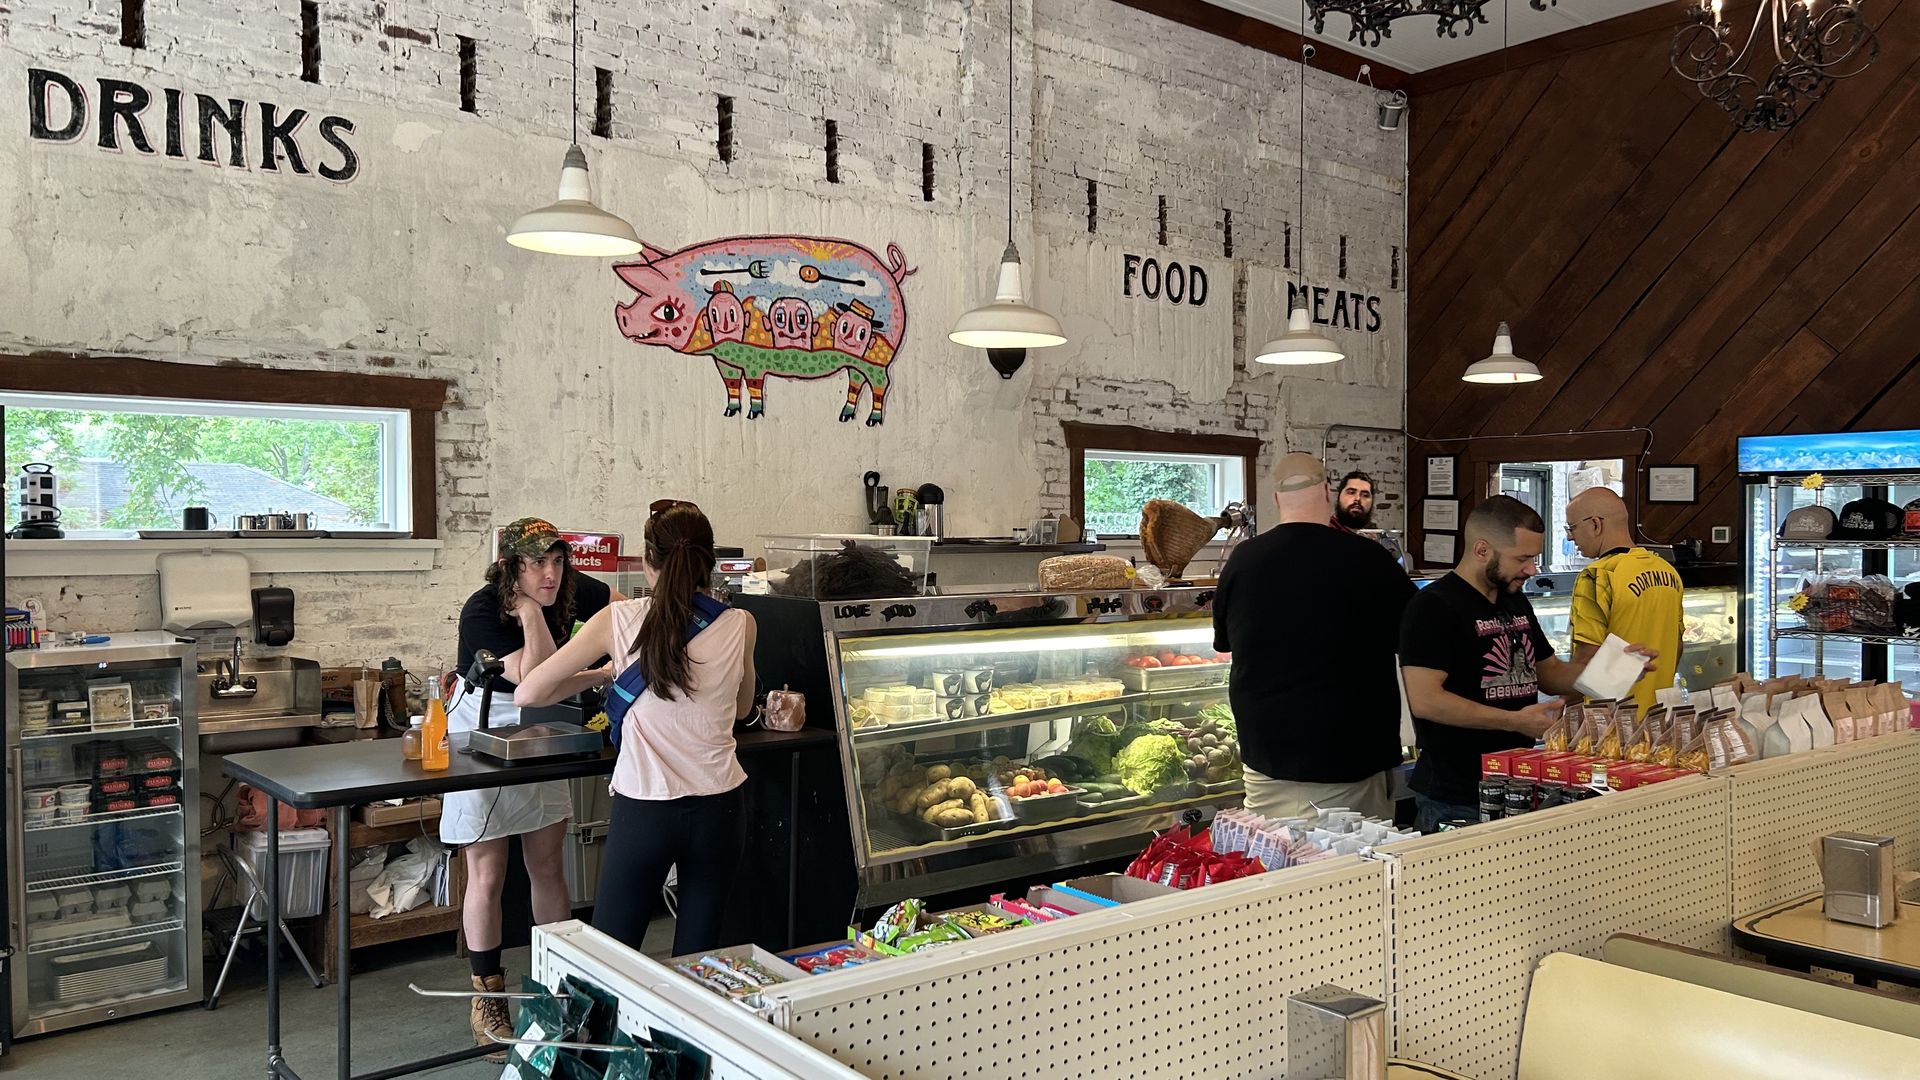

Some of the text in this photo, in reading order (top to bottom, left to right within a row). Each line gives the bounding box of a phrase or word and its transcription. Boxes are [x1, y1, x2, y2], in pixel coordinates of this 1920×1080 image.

[28, 68, 357, 182] DRINKS
[1123, 254, 1208, 306] FOOD
[1287, 281, 1381, 332] MEATS
[569, 554, 602, 567] ducts
[834, 604, 871, 619] LOVE
[1485, 685, 1510, 699] 1988
